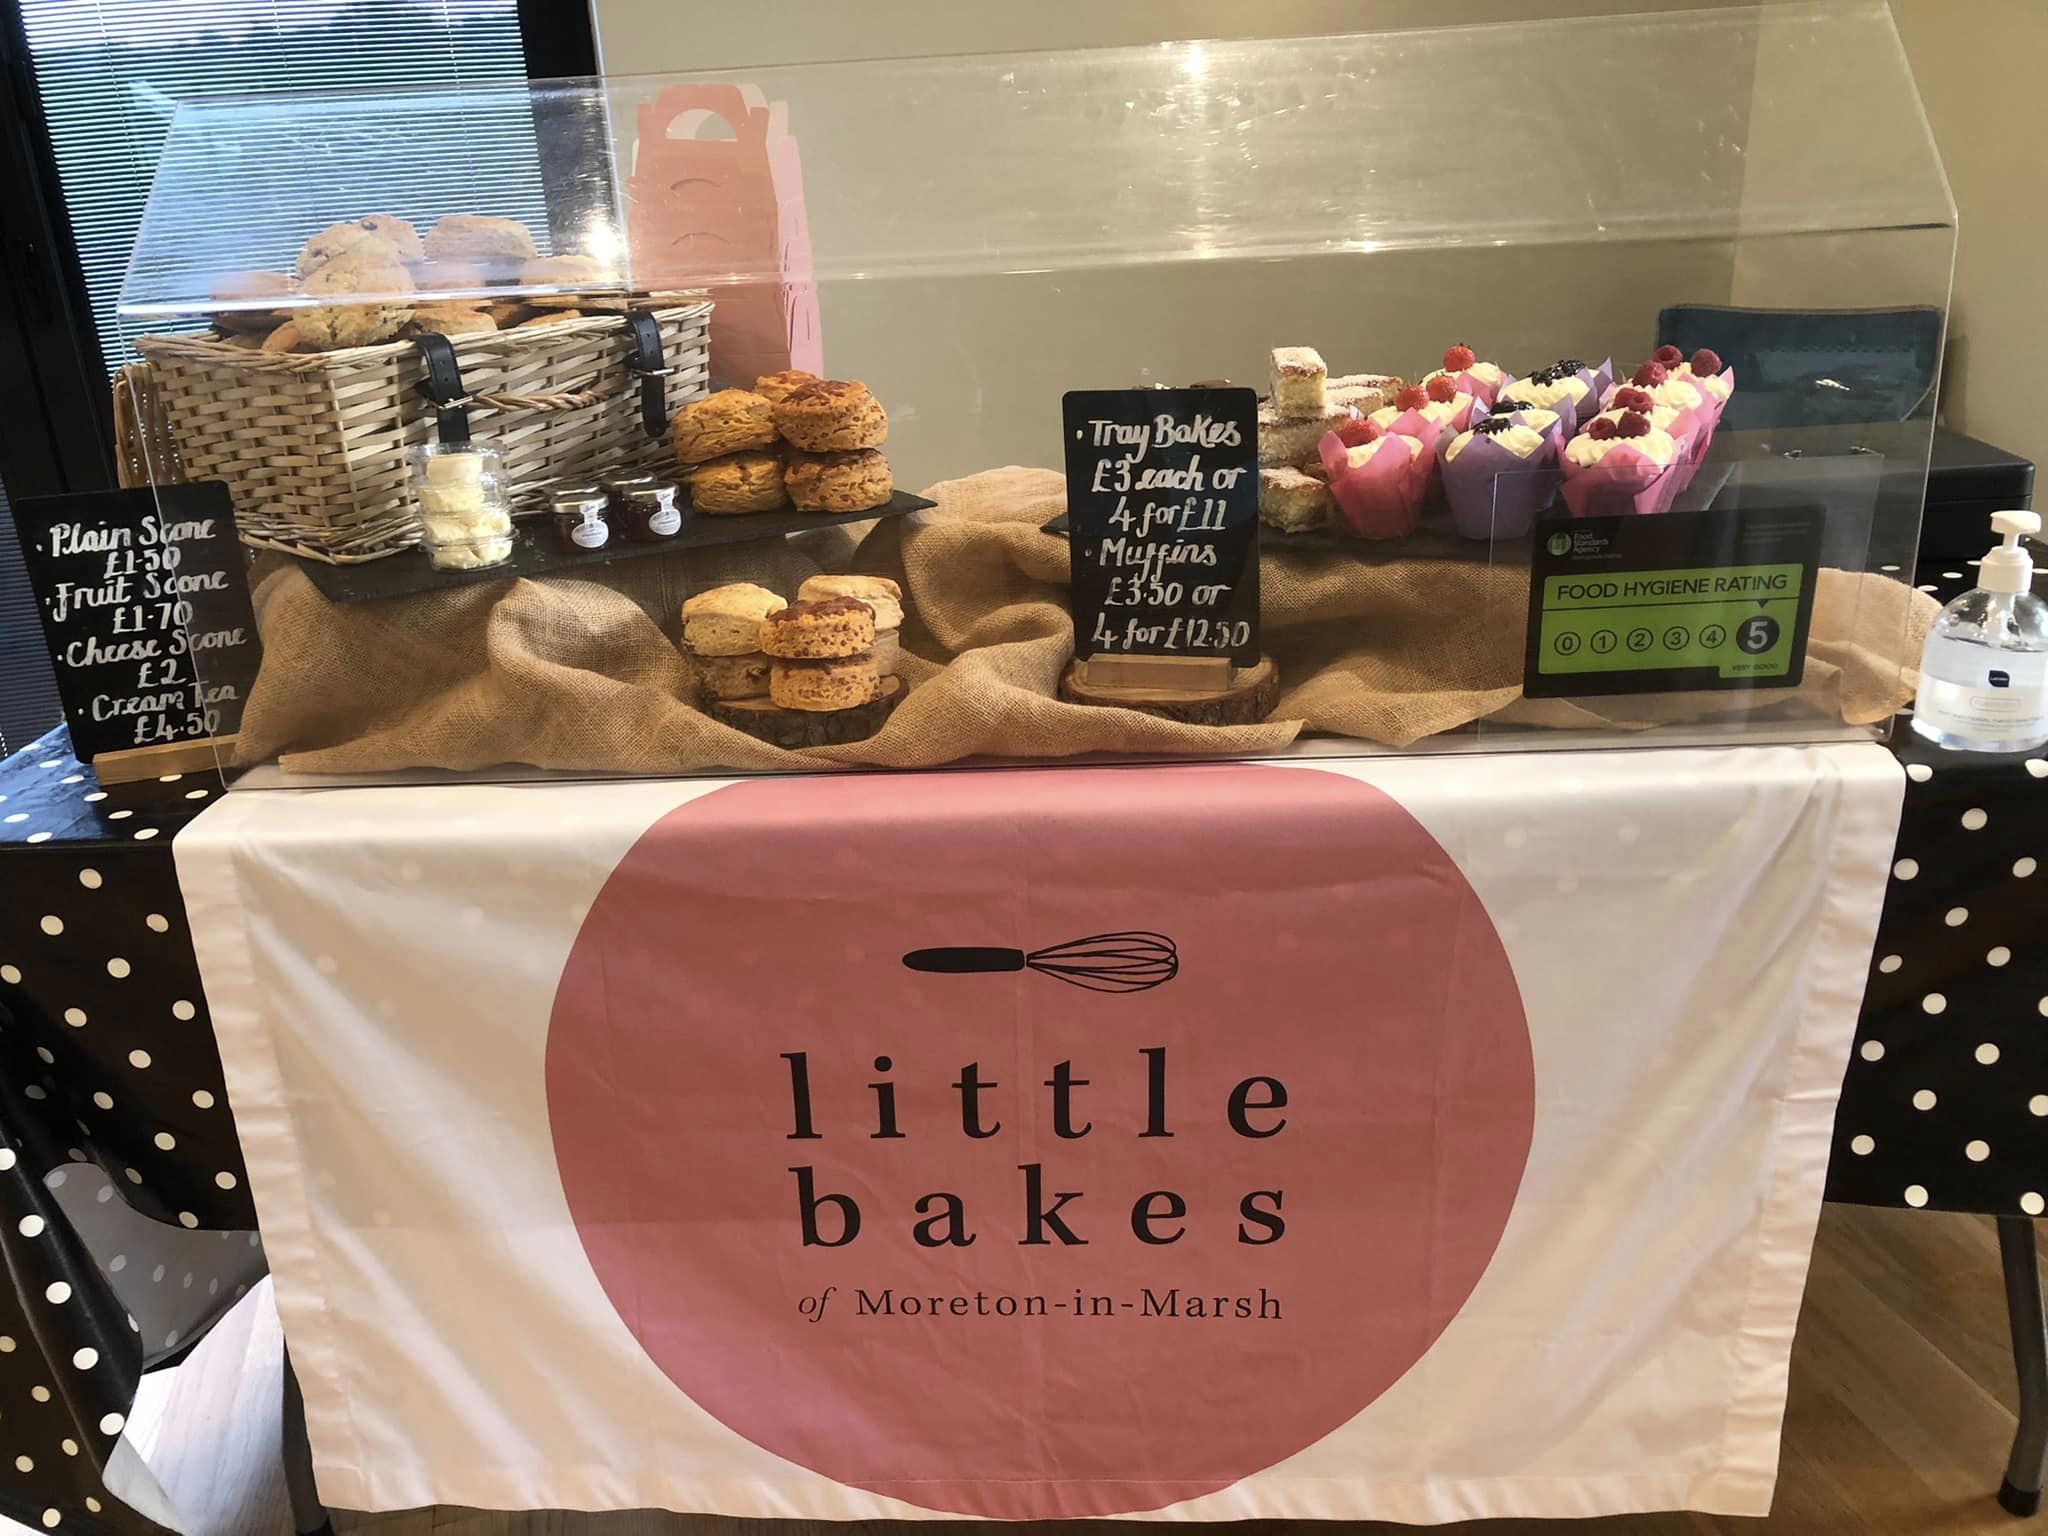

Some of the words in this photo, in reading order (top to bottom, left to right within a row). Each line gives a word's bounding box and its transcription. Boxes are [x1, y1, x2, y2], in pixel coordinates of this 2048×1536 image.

[1088, 419, 1150, 464] Tray
[1152, 413, 1242, 448] Bakes
[1091, 458, 1131, 493] £3
[1134, 454, 1205, 492] each
[1211, 468, 1248, 490] or
[49, 518, 132, 557] Plain
[138, 515, 217, 546] Scone
[1108, 495, 1136, 532] 4
[1135, 502, 1181, 538] for
[1177, 496, 1228, 533] £11
[1099, 537, 1218, 584] Muffins
[52, 576, 133, 622] Fruit
[143, 570, 230, 599] Scone
[1191, 583, 1232, 607] or
[1557, 581, 1618, 600] FOOD
[1623, 578, 1709, 597] HYGIENE
[1714, 573, 1788, 592] RATING
[65, 637, 162, 668] Cheese
[169, 627, 248, 655] Scone
[1091, 612, 1118, 649] 4
[1122, 617, 1166, 650] for
[1746, 620, 1769, 650] 5
[137, 660, 187, 689] £2
[91, 692, 185, 722] Cream
[188, 680, 241, 708] Tea
[780, 1046, 1289, 1140] little
[788, 1162, 1287, 1248] bakes
[797, 1286, 837, 1323] of
[855, 1288, 1283, 1320] Moreton-in-Marsh
